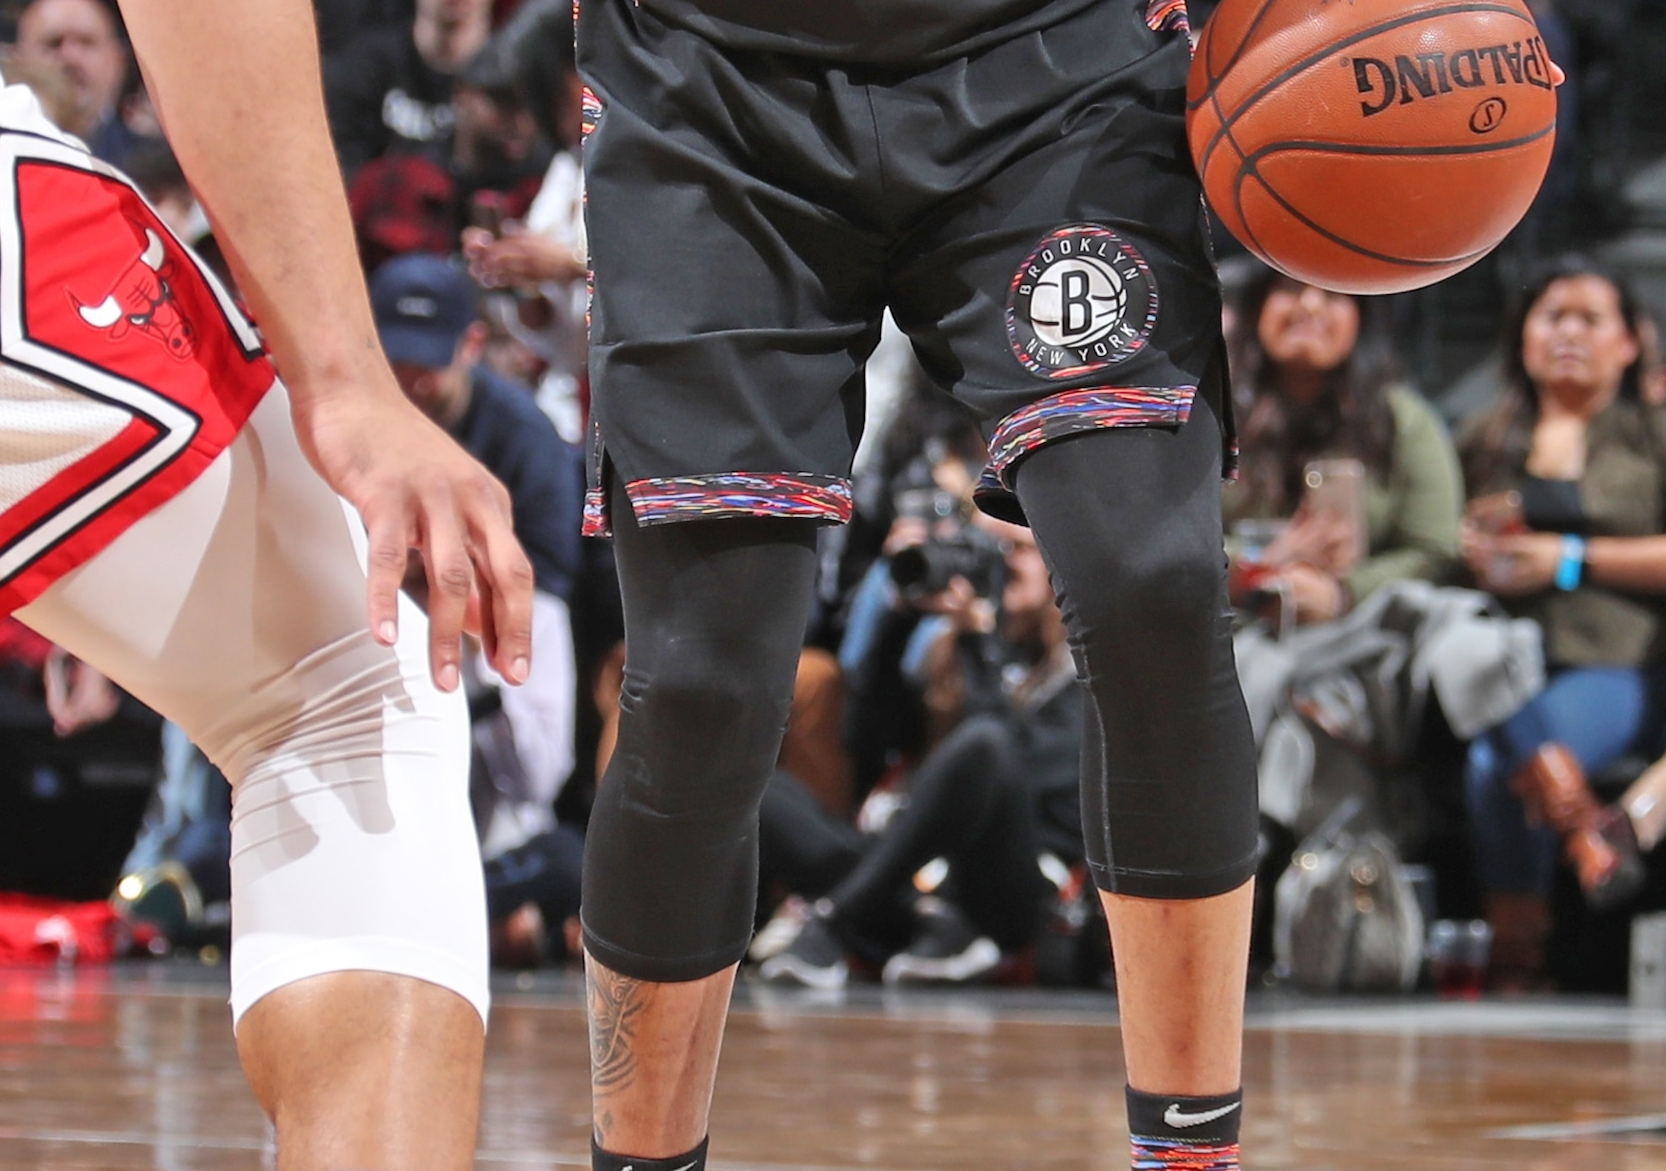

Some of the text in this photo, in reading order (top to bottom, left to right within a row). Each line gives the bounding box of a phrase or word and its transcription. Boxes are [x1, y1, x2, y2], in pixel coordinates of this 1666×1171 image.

[1019, 237, 1140, 296] BROOKLYN
[1061, 269, 1093, 337] B
[1025, 322, 1140, 366] NEW YORK
